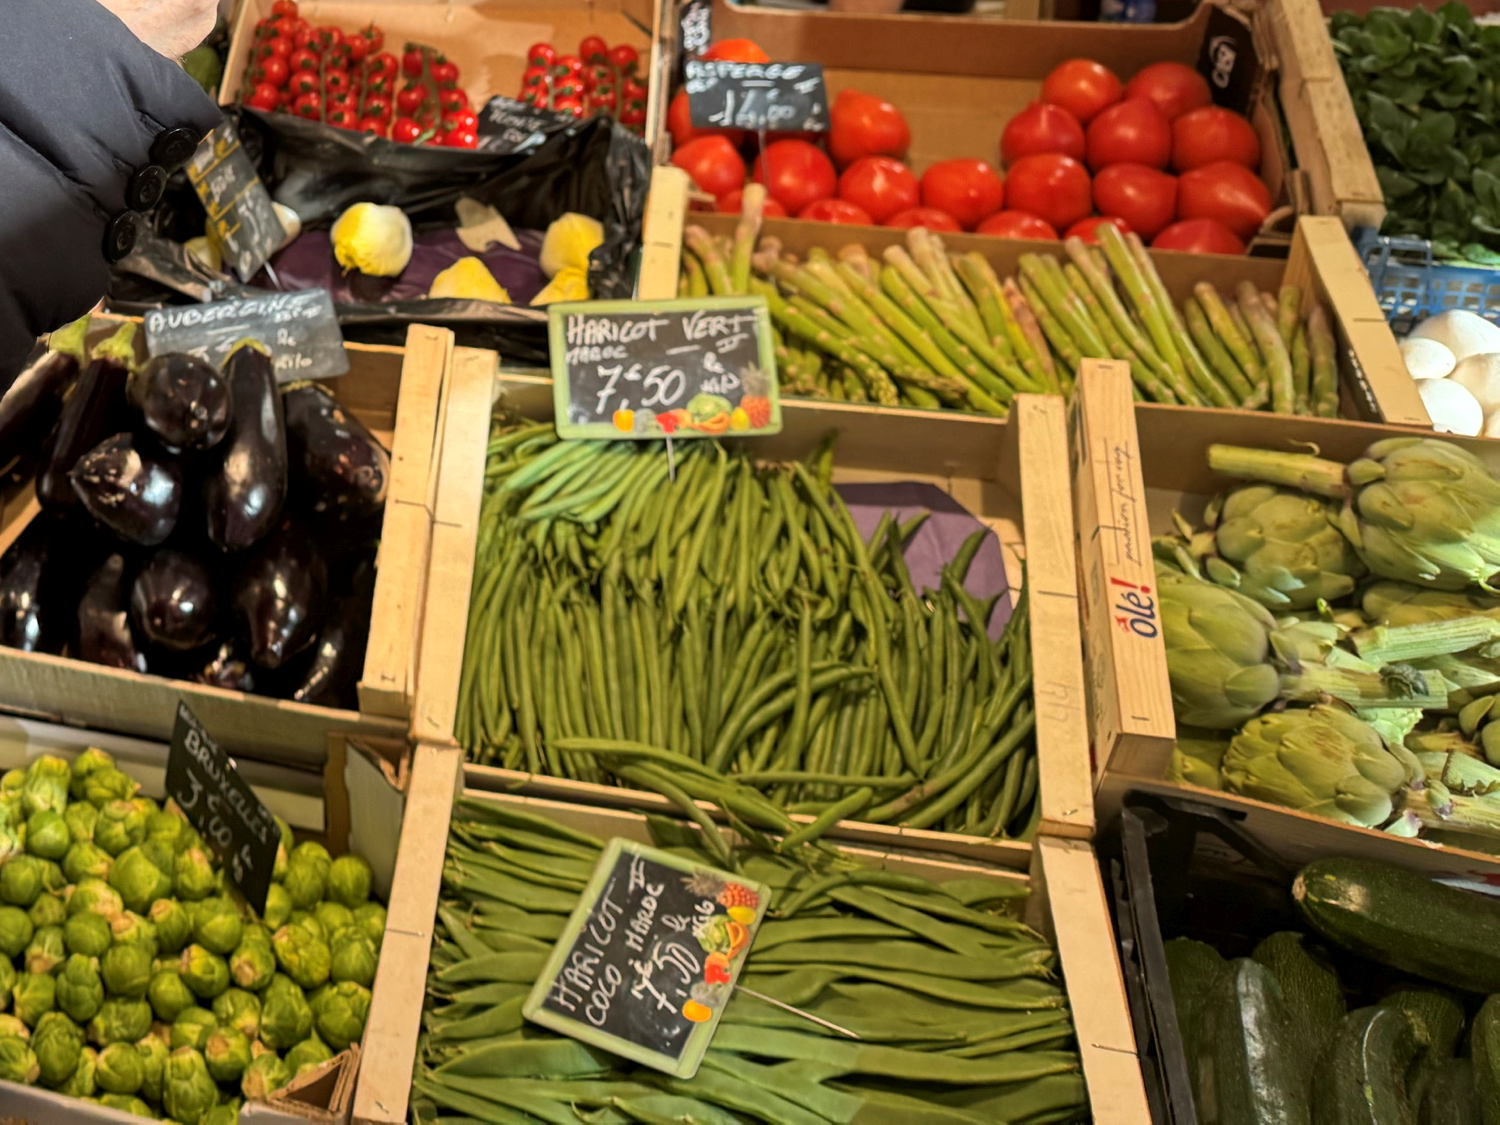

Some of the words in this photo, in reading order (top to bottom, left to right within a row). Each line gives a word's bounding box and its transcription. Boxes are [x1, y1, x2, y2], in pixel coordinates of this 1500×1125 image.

[149, 290, 327, 332] AUBERGINE
[567, 314, 669, 345] HARICOT
[682, 310, 758, 340] VERT
[183, 729, 269, 845] BRUXELLES
[551, 877, 624, 1012] HARICOT
[585, 964, 622, 1026] COCO
[625, 883, 665, 953] MAROC
